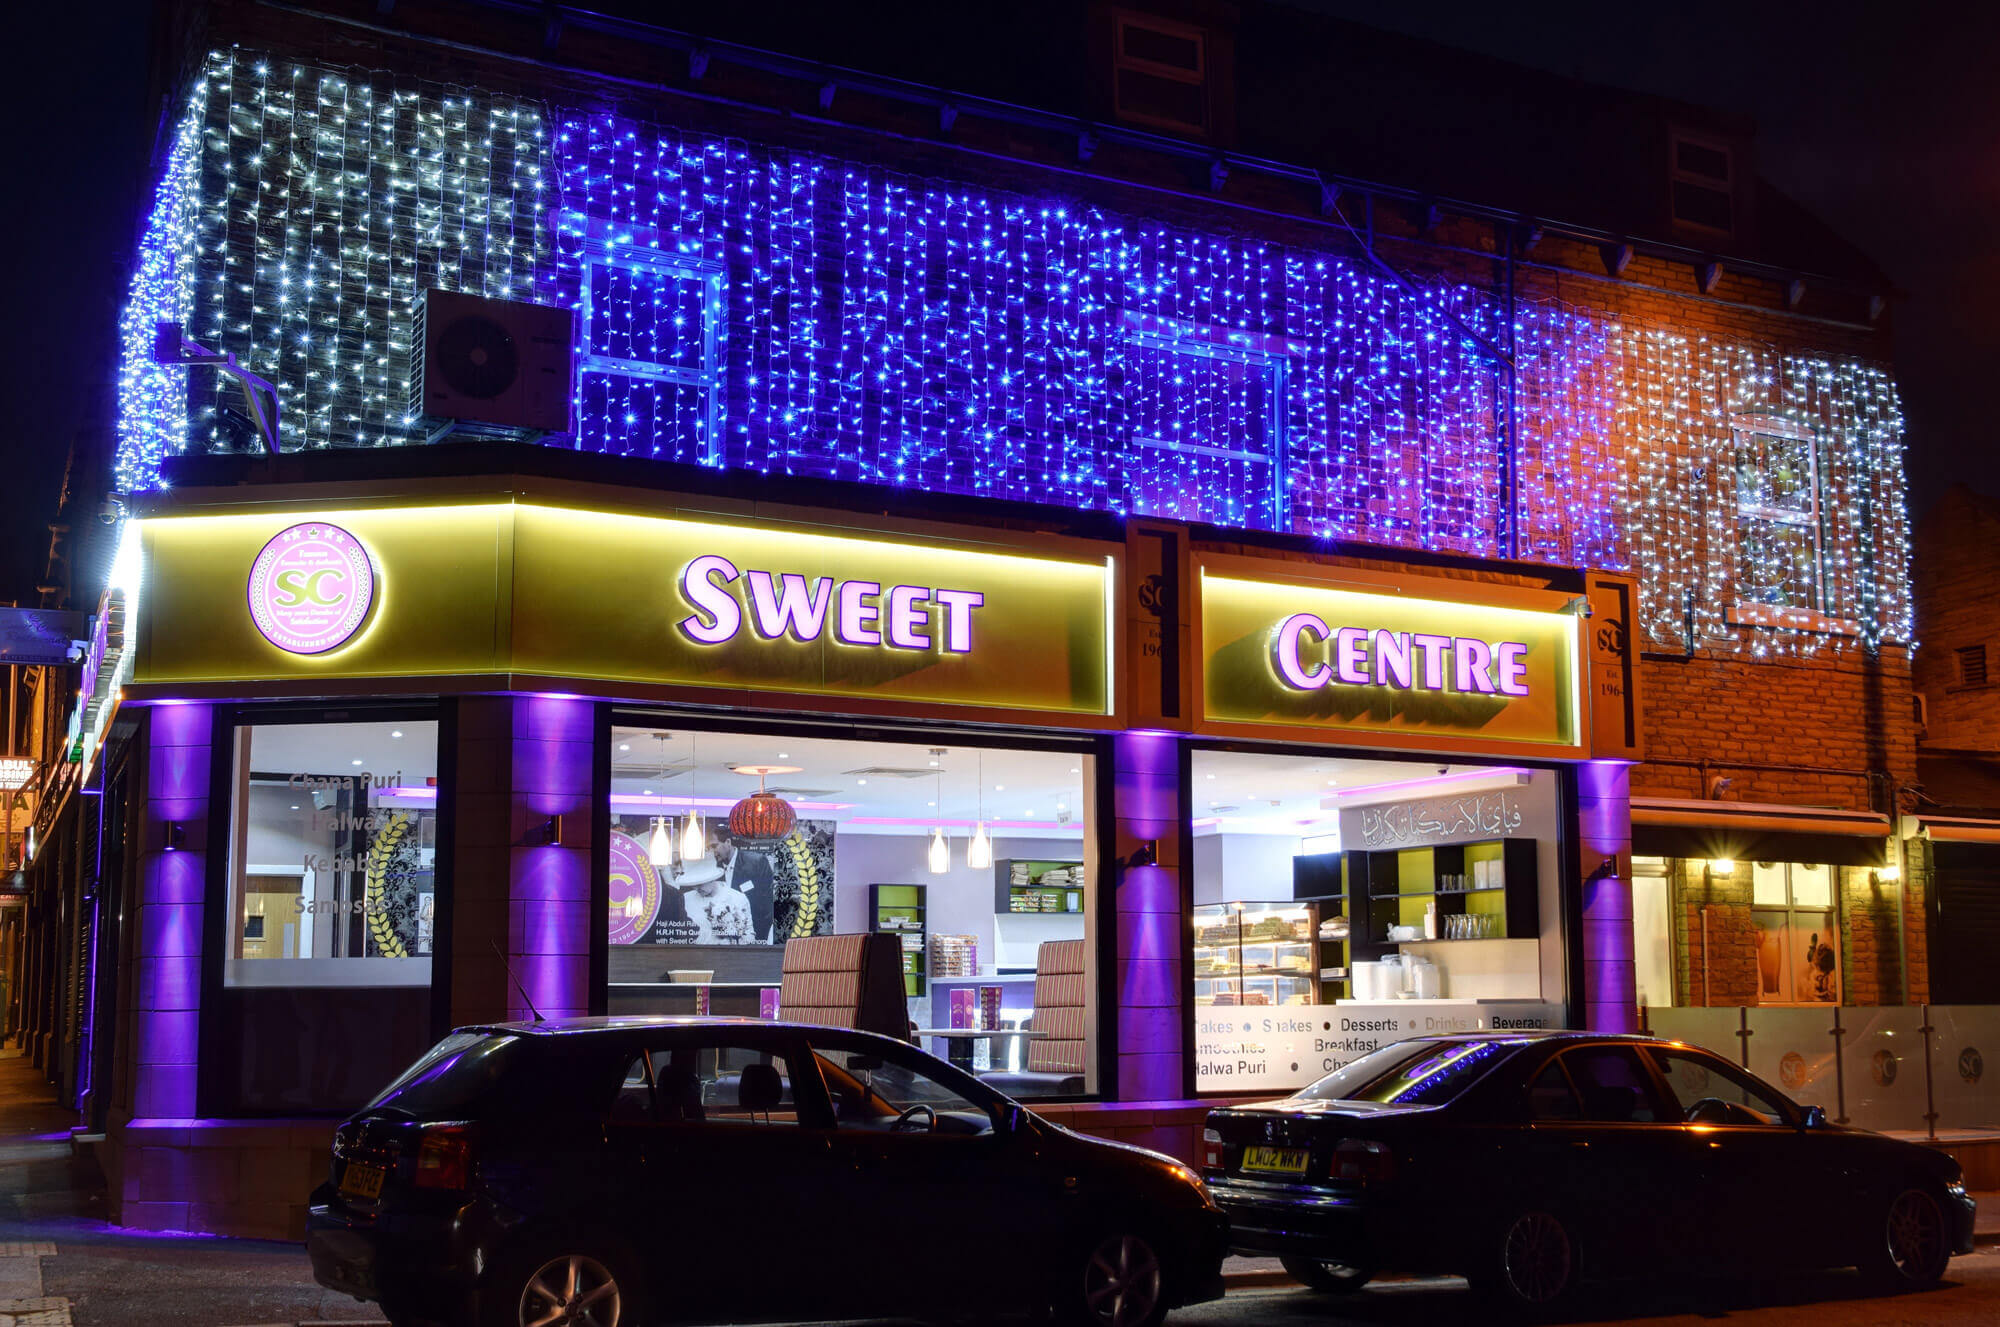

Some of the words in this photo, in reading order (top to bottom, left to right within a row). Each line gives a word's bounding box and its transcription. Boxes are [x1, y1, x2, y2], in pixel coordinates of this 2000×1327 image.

[273, 568, 346, 608] SC
[677, 554, 984, 655] SWEET
[1271, 612, 1530, 697] CENTRE
[288, 773, 353, 791] Chana
[360, 771, 402, 790] Puri
[1196, 1019, 1234, 1034] akes
[1340, 1017, 1399, 1032] Desserts
[1425, 1016, 1467, 1031] Drinks
[1314, 1037, 1378, 1053] Breakfast
[1238, 1060, 1266, 1075] Puri
